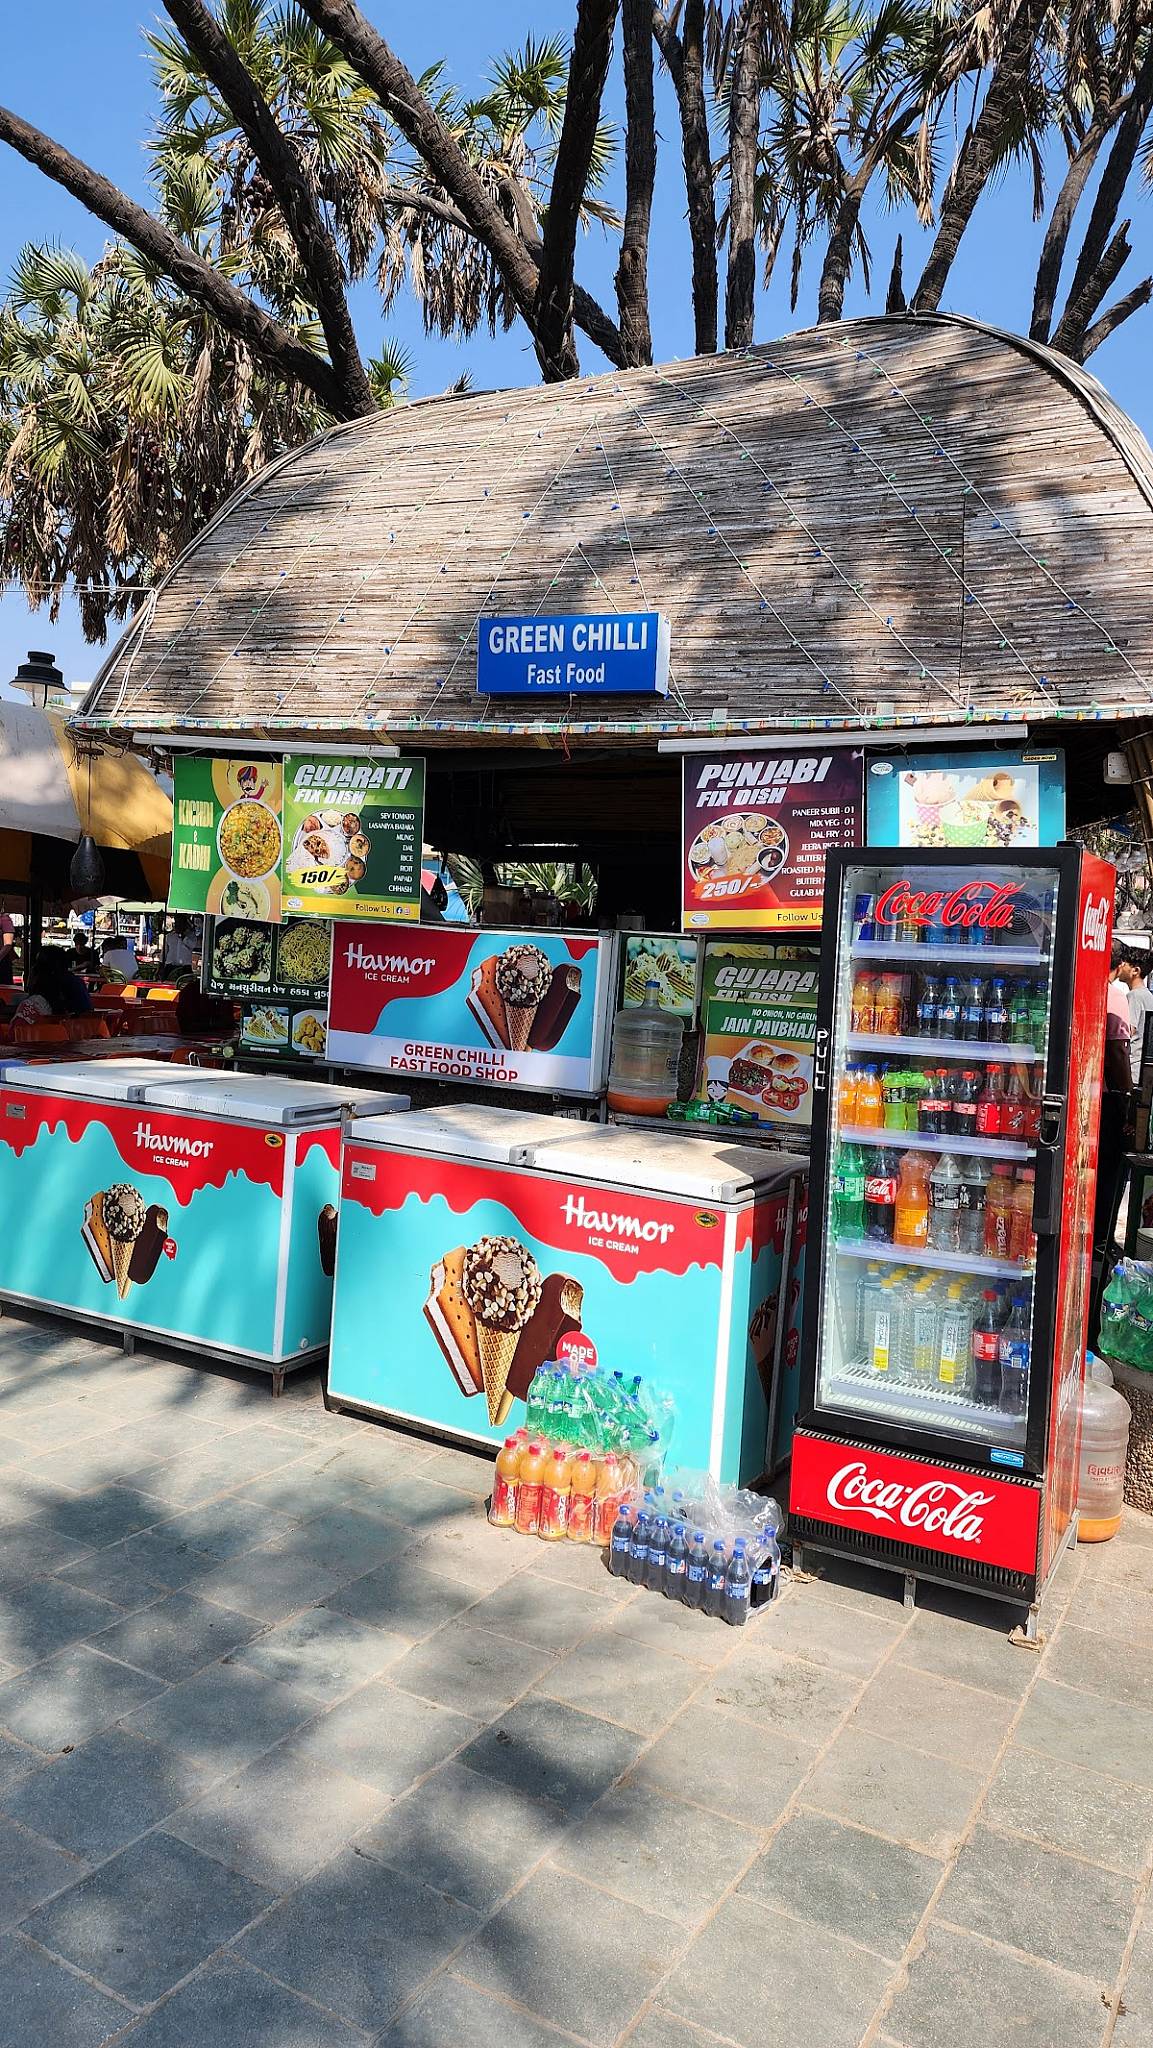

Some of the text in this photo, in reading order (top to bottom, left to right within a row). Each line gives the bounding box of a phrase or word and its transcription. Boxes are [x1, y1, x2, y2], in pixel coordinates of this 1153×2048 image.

[488, 622, 648, 654] GREEN CHILLI
[527, 662, 605, 684] Fast Food
[294, 764, 413, 790] GUJARATI
[696, 757, 833, 789] PUNJABI
[294, 788, 366, 805] FIX DISH
[696, 787, 787, 808] FIX DISH
[792, 808, 819, 816] PANEER
[810, 820, 824, 828] MIX
[801, 843, 823, 851] JEERA
[796, 854, 822, 862] BUTTER
[301, 870, 342, 884] 150/-
[393, 875, 413, 883] PAPAD
[796, 877, 821, 885] BUTTER
[388, 885, 412, 893] CHHASH
[700, 877, 758, 899] 250/-
[356, 904, 390, 913] Follow Us
[875, 880, 1026, 928] Coca-Cola
[778, 913, 808, 921] Follow
[1082, 892, 1110, 952] Coca-Cola
[343, 942, 436, 976] Havmor
[364, 972, 410, 984] ICE CREAM
[714, 966, 818, 993] GUJARA
[720, 1016, 752, 1033] JAIN
[786, 1011, 795, 1019] NO
[404, 1044, 504, 1066] GREEN CHILLI
[814, 1029, 829, 1091] PULL
[390, 1056, 518, 1081] FAST FOOD SHOP
[132, 1122, 214, 1158] Havmor
[153, 1155, 189, 1168] ICE CREAM
[560, 1194, 675, 1244] Havmor
[588, 1236, 639, 1255] ICE CREAM
[996, 1216, 1006, 1256] maaza
[562, 1341, 594, 1359] MADE
[826, 1462, 996, 1542] Coca-Cola
